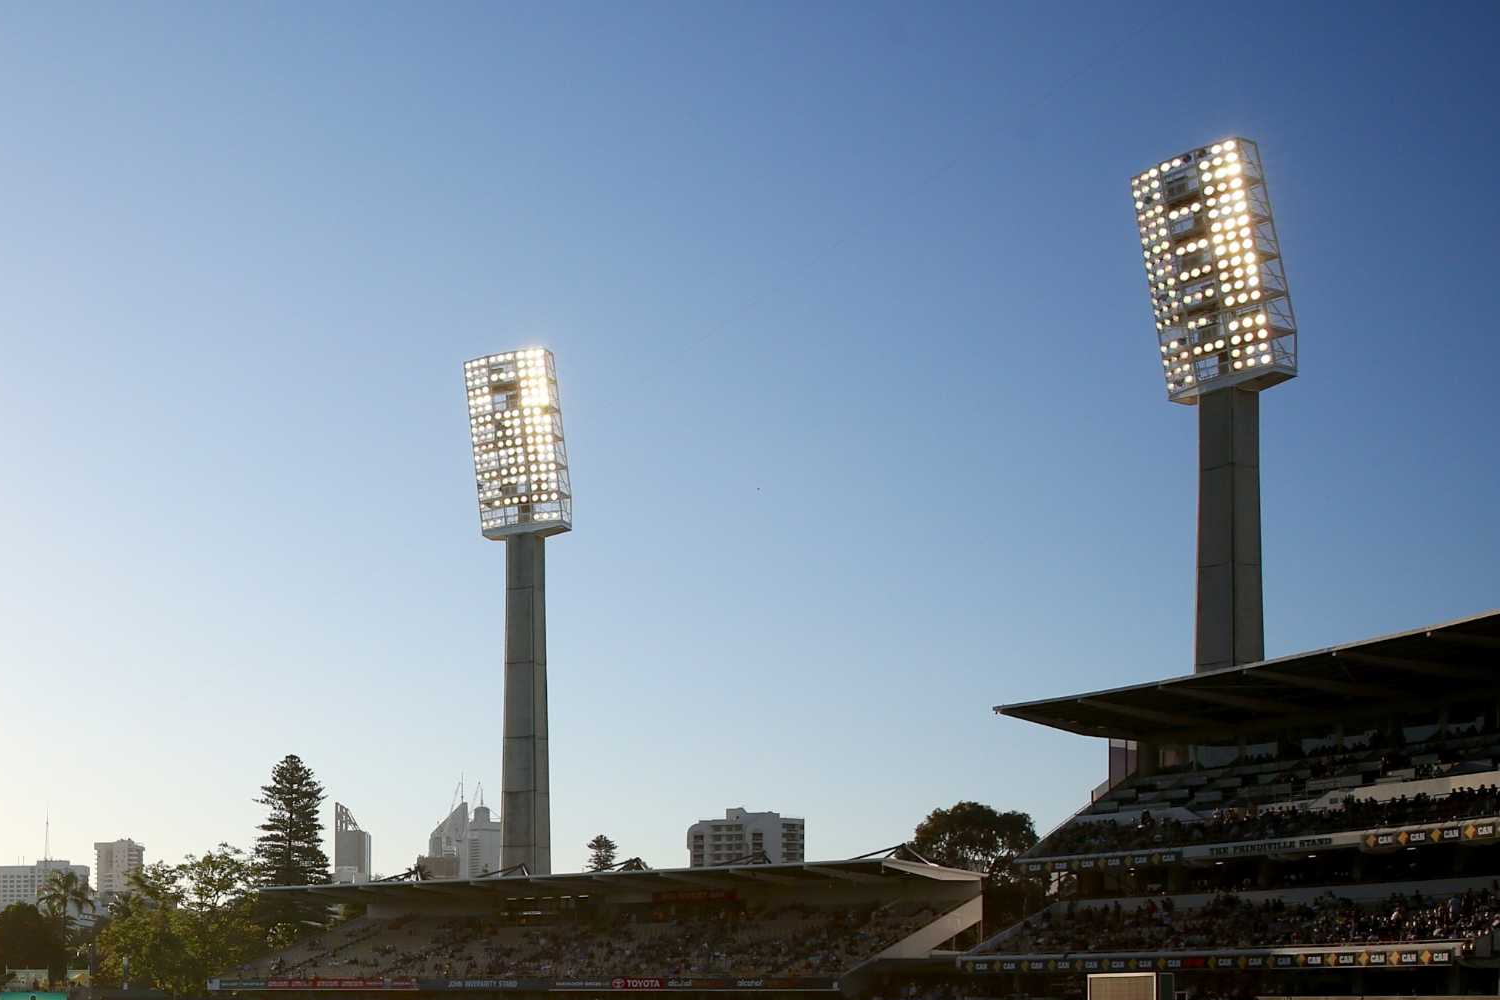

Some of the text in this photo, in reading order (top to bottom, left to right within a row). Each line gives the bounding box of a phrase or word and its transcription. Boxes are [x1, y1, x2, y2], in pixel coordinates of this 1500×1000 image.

[1444, 830, 1459, 838] CAN
[1478, 826, 1493, 835] CAN
[1410, 833, 1425, 841] CAN
[1370, 954, 1385, 963] CAN
[1401, 954, 1417, 962] CAN
[1433, 952, 1449, 961] CAN
[627, 979, 661, 988] TOYOTA
